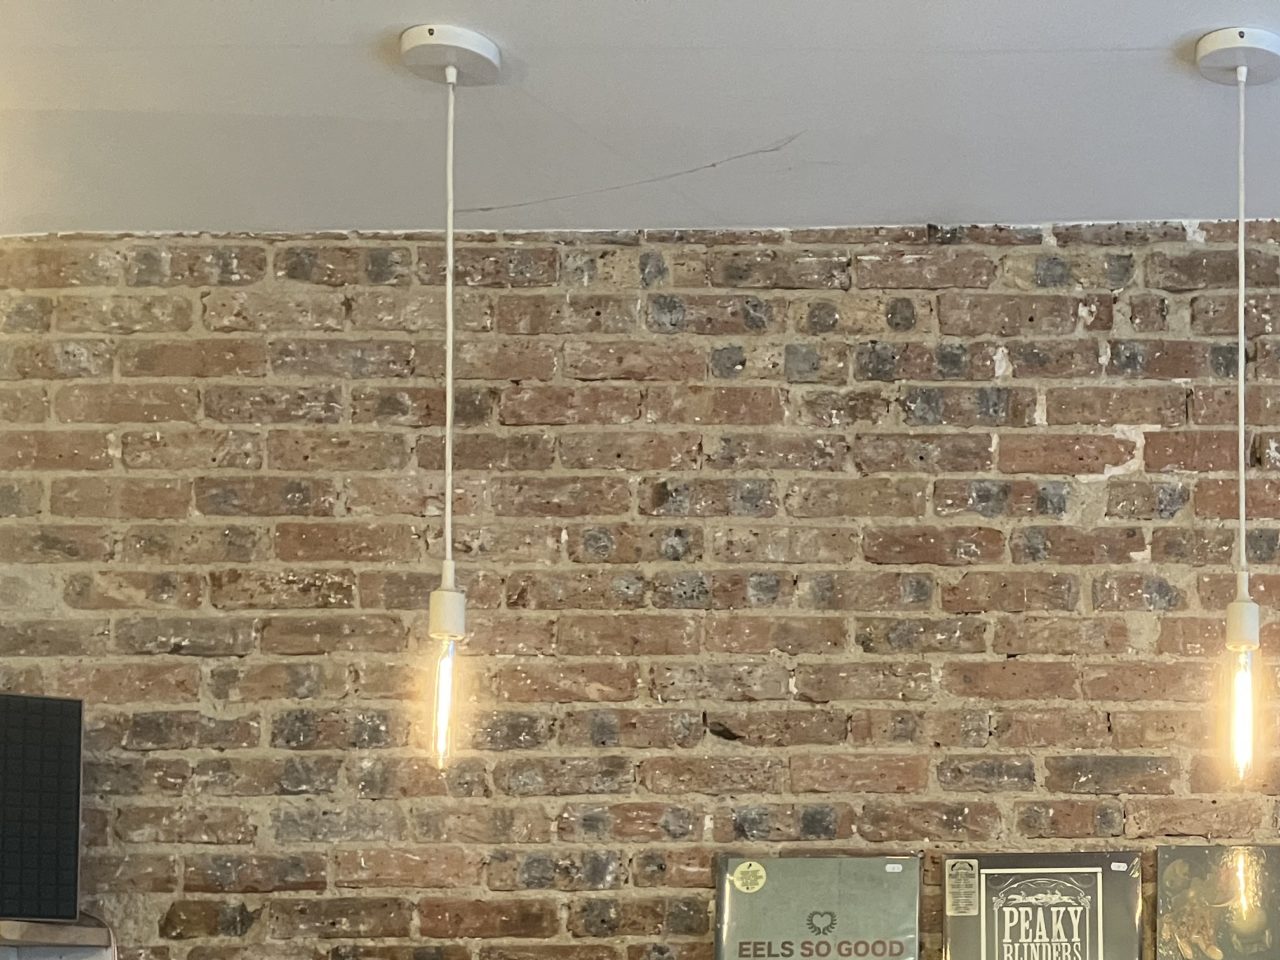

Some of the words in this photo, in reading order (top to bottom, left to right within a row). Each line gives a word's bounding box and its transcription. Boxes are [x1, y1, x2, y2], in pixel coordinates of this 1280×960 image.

[1003, 906, 1083, 943] PEAKY
[738, 941, 795, 959] EELS
[800, 940, 832, 958] SO
[836, 940, 904, 958] GOOD
